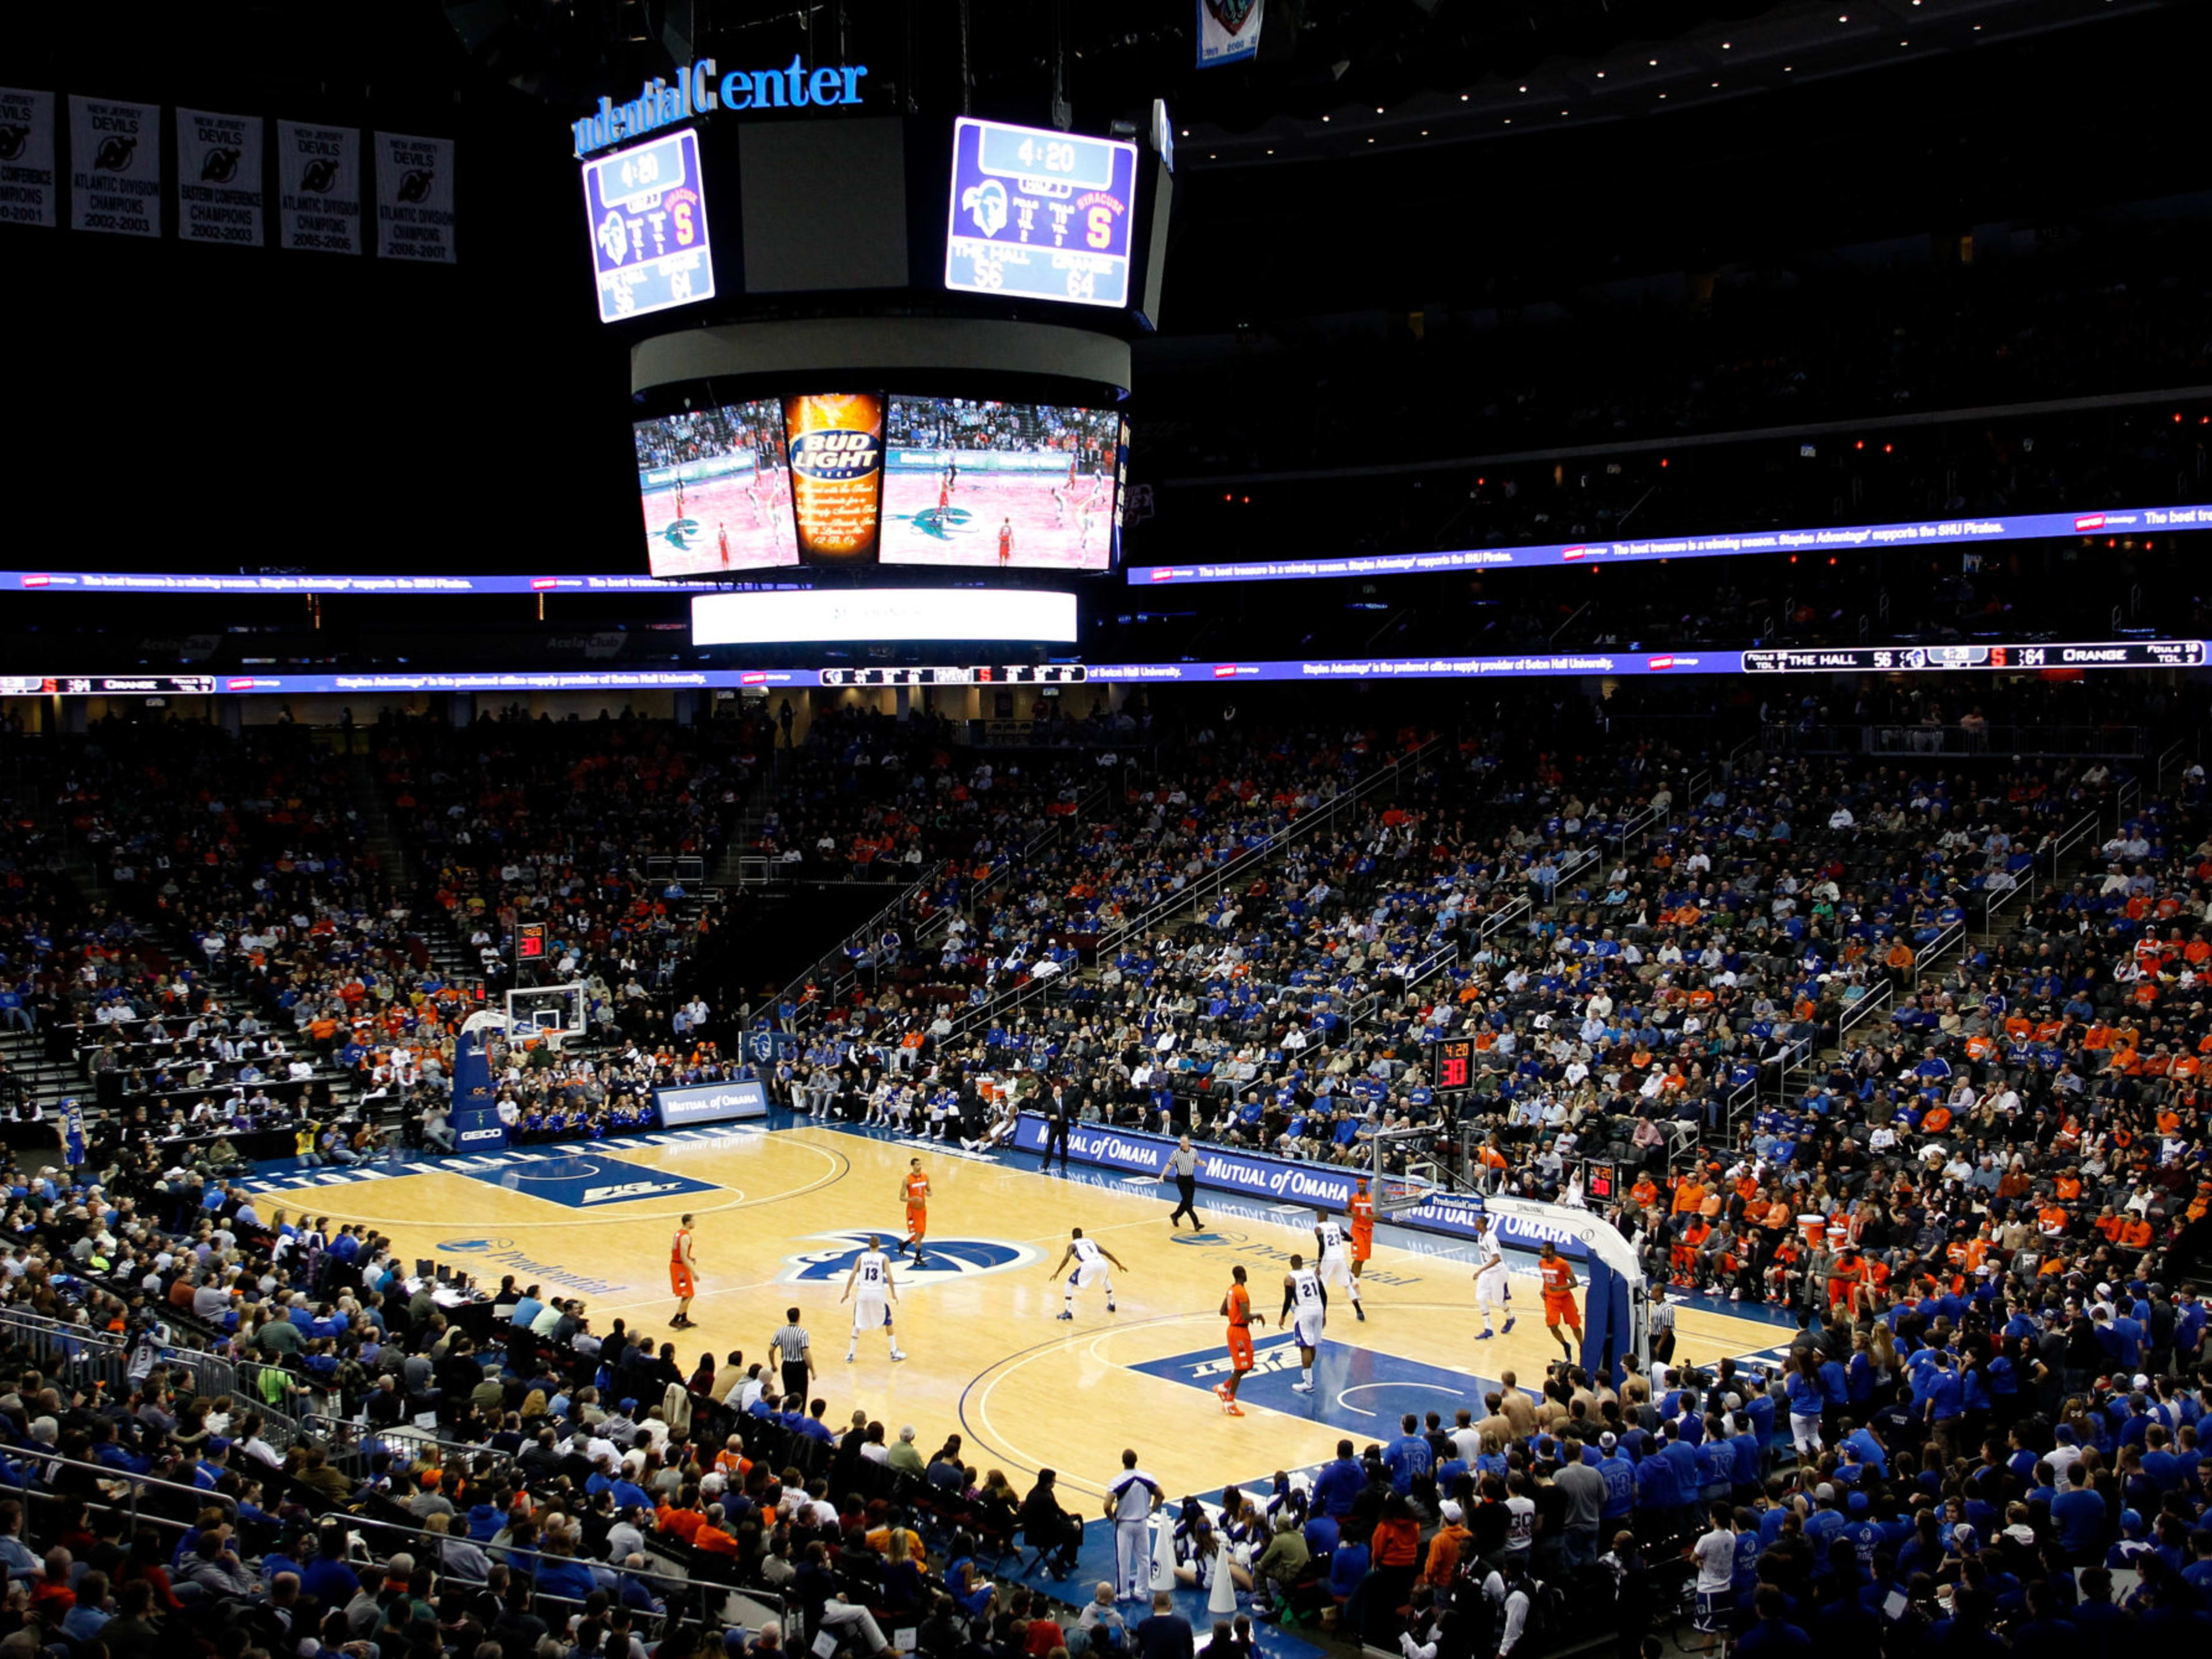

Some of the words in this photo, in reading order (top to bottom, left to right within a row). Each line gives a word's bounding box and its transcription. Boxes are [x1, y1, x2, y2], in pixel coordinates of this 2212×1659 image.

[692, 56, 868, 113] Center
[92, 116, 138, 134] DEVILS
[199, 128, 243, 146] DEVILS
[298, 140, 340, 157] DEVILS
[1018, 138, 1075, 174] 4:20
[394, 150, 435, 168] DEVILS
[74, 173, 118, 192] ATLANTIC
[119, 179, 159, 196] DIVISION
[90, 195, 144, 215] CHAMPIONS
[283, 195, 321, 214] ATLANTIC
[323, 200, 359, 218] DIVISION
[85, 214, 150, 232] 2002-2003
[190, 205, 253, 225] CHAMPIONS
[297, 215, 346, 234] CHAMPIONS
[380, 205, 417, 224] ATLANTIC
[418, 209, 455, 227] DIVISION
[191, 224, 253, 243] 2002-2003
[393, 225, 440, 243] CHAMPIONS
[804, 433, 870, 452] BUD
[794, 450, 878, 468] LIGHT
[2145, 511, 2167, 524] The
[2168, 510, 2195, 523] best
[1613, 544, 1629, 555] The
[1630, 543, 1649, 554] best
[1688, 540, 1697, 551] is
[1698, 541, 1705, 551] a
[1705, 539, 1740, 551] winning
[1778, 533, 1815, 547] Staples
[1872, 527, 1918, 542] supports
[1919, 526, 1937, 537] the
[1937, 524, 1963, 536] SHU
[1963, 522, 2005, 535] Pirates.
[1199, 567, 1214, 577] The
[1215, 566, 1233, 576] best
[1268, 564, 1277, 574] is
[1277, 566, 1283, 574] a
[1284, 563, 1316, 574] winning
[1349, 560, 1375, 571] Staples
[1417, 555, 1450, 569] supports
[1451, 554, 1464, 565] the
[1464, 552, 1483, 564] SHU
[1303, 664, 1330, 676] Staples
[1372, 662, 1380, 673] is
[1380, 662, 1393, 673] the
[1394, 661, 1429, 675] preferred
[1430, 661, 1452, 672] office
[1453, 660, 1480, 673] supply
[1480, 659, 1514, 673] provider
[1515, 659, 1525, 670] of
[1525, 658, 1551, 670] Seton
[1551, 658, 1569, 669] Hall
[1569, 657, 1614, 671] University.
[1789, 655, 1816, 666] THE
[1819, 654, 1857, 665] HALL
[1873, 651, 1892, 668] 56
[2025, 649, 2044, 665] 64
[2157, 654, 2181, 663] TOL
[1089, 667, 1099, 677] of
[1099, 667, 1123, 677] Seton
[1123, 666, 1140, 677] Hall
[1141, 666, 1181, 679] University.
[336, 677, 374, 688] Staples
[520, 936, 541, 956] 30
[1441, 1058, 1467, 1086] 30
[666, 1100, 709, 1113] MUTUAL
[709, 1095, 721, 1109] of
[721, 1094, 759, 1107] OMAHA
[461, 1127, 503, 1141] GEICO
[246, 1167, 394, 1191] ETON
[551, 1124, 771, 1156] PIRATES
[1090, 1138, 1108, 1160] of
[1108, 1138, 1157, 1166] OMAHA
[1206, 1157, 1266, 1187] MUTUAL
[1270, 1169, 1293, 1195] of
[1291, 1172, 1349, 1202] OMAHA
[1591, 1177, 1611, 1196] 30
[1516, 1203, 1545, 1217] SPALDING
[1505, 1212, 1572, 1245] OMAHA
[1327, 1233, 1341, 1247] 23
[486, 1251, 627, 1296] Prudential
[864, 1267, 878, 1281] 13
[1301, 1282, 1319, 1298] 21
[140, 1349, 148, 1361] 3
[1611, 1473, 1631, 1499] 13
